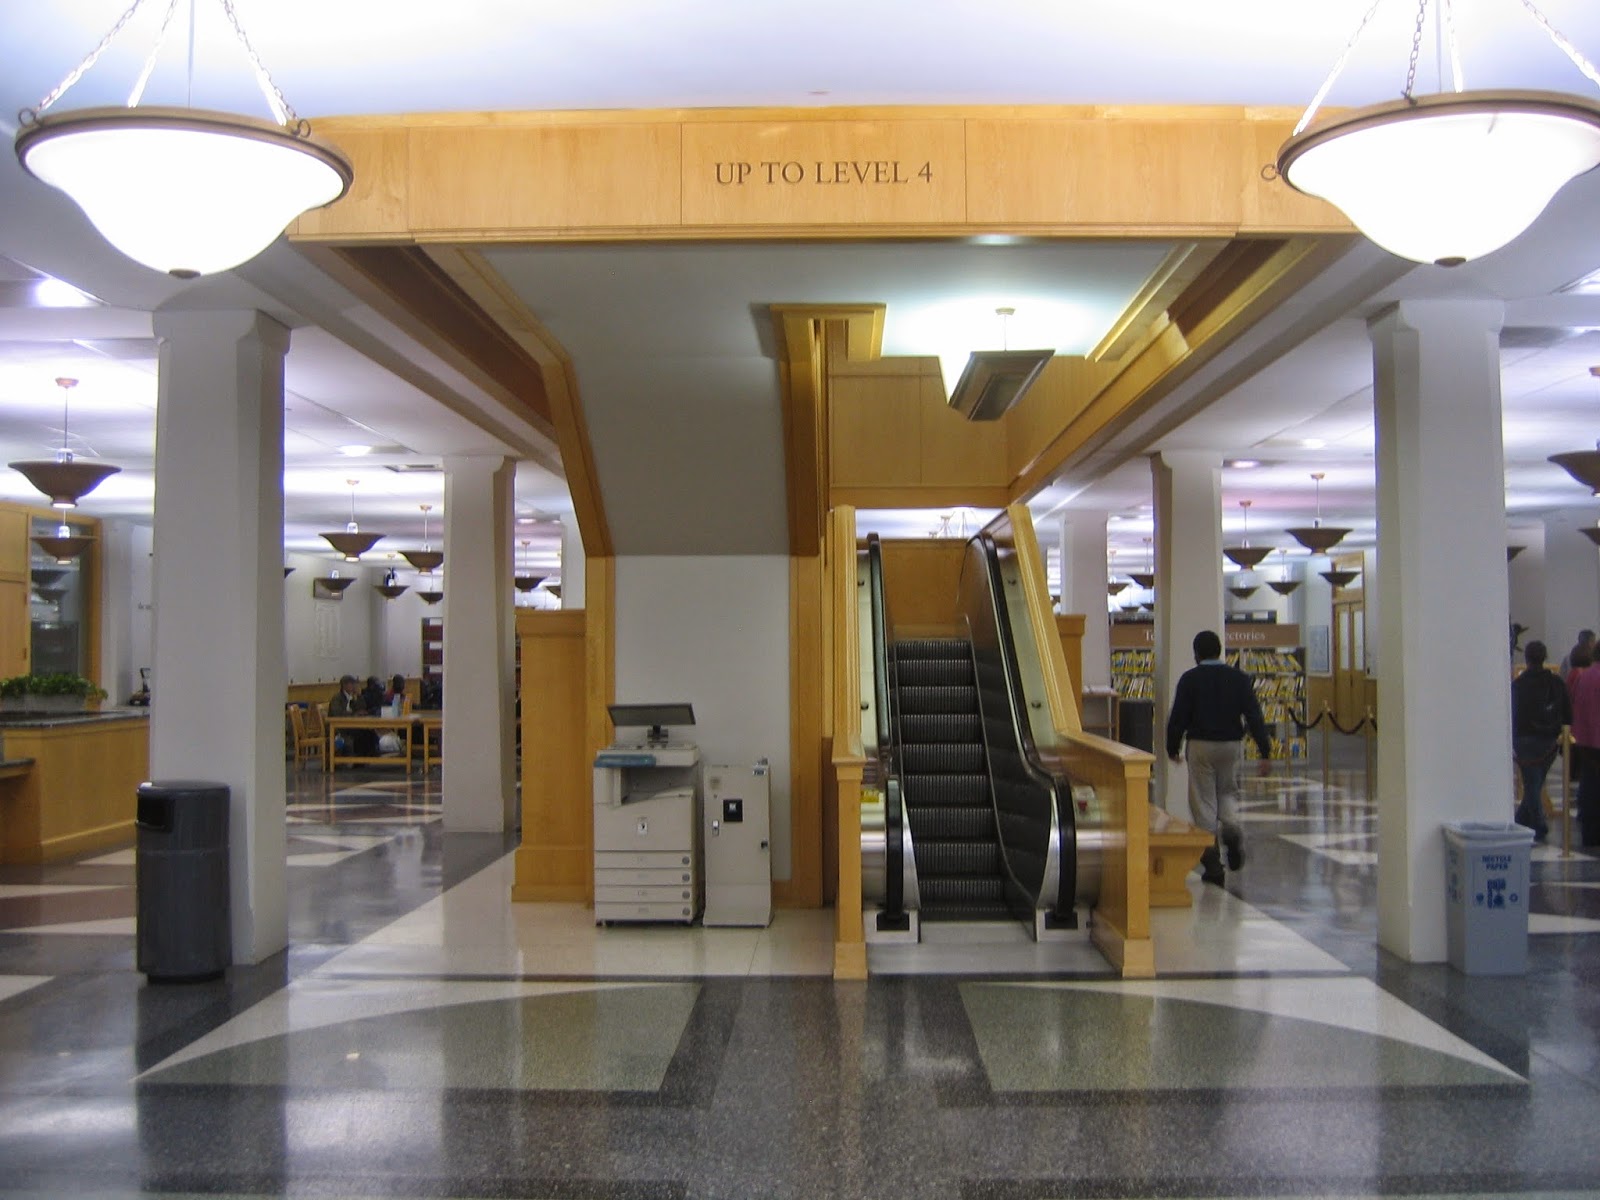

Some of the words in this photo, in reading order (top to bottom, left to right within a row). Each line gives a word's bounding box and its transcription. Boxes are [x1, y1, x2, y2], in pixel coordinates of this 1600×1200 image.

[715, 161, 752, 186] UP
[760, 161, 805, 185] TO
[815, 161, 908, 185] LEVEL
[917, 161, 933, 184] 4
[1225, 629, 1266, 641] ectories
